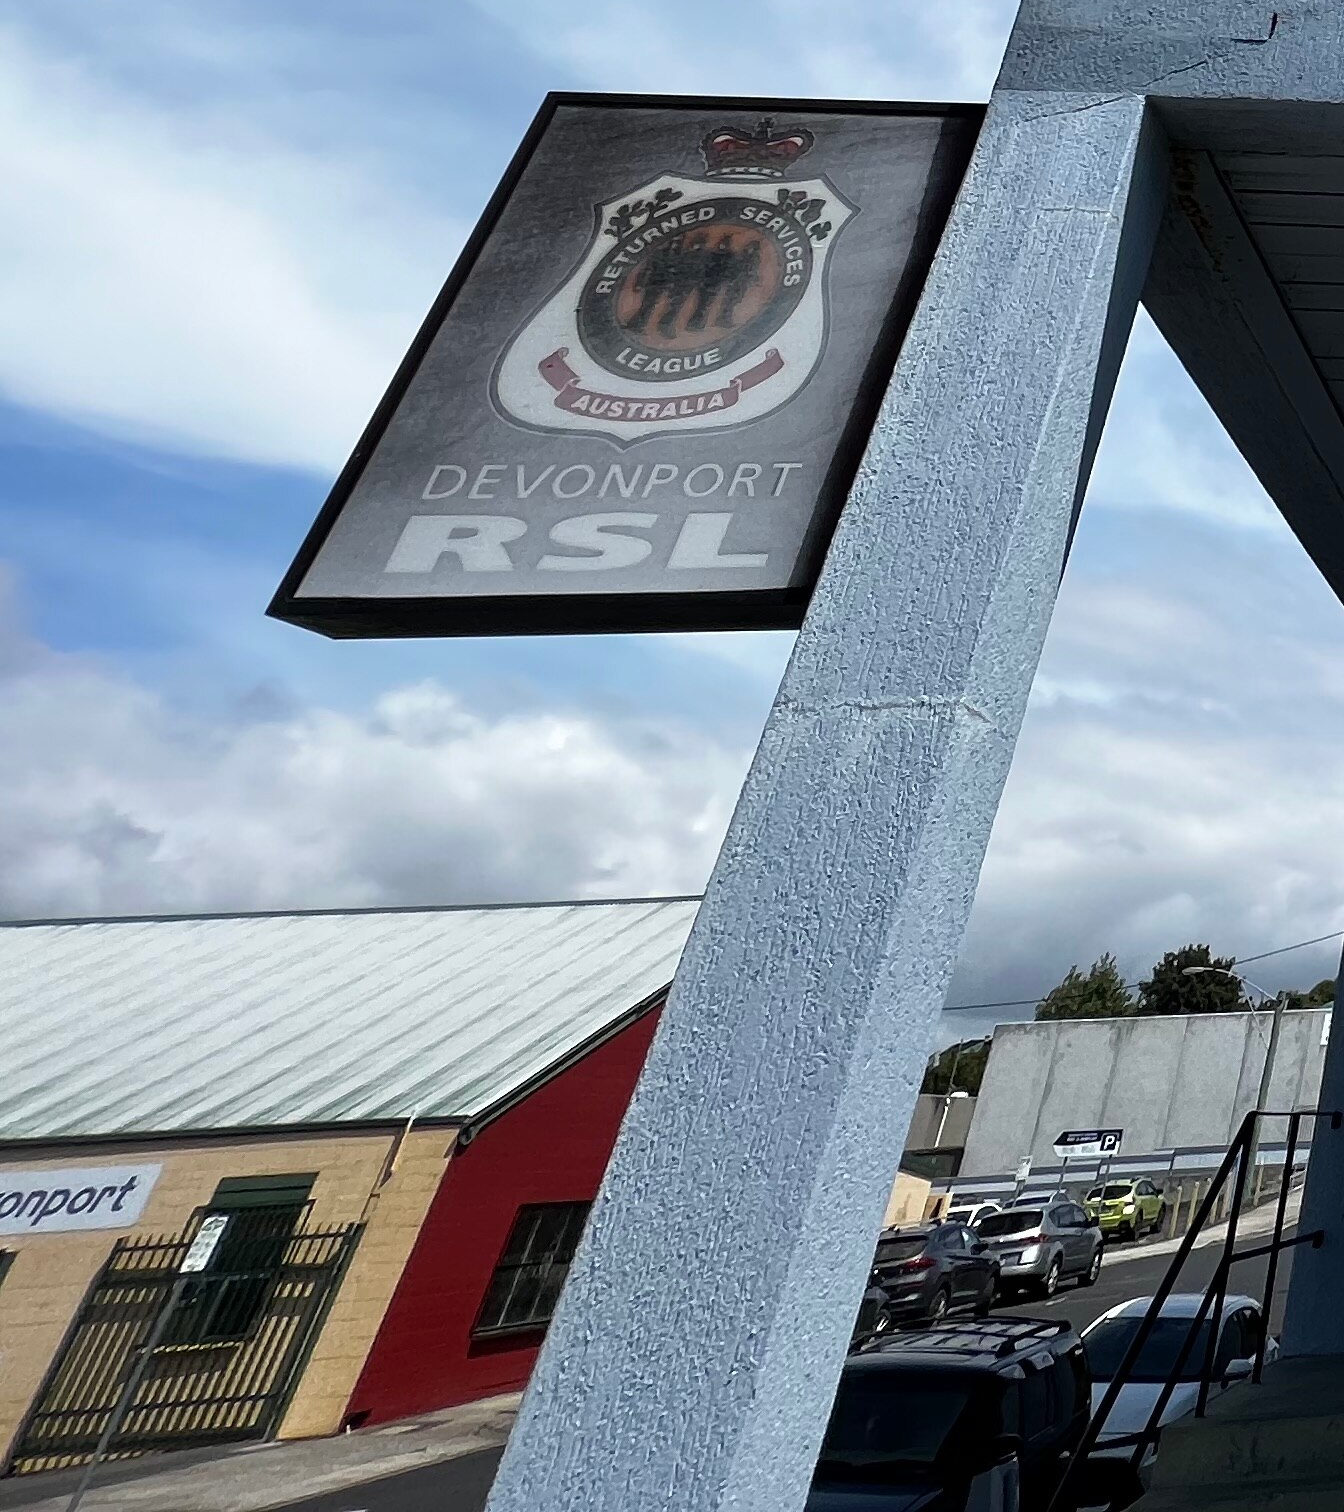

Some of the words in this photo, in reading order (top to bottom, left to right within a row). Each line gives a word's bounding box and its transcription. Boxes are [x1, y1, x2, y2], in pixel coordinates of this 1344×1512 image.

[595, 205, 717, 295] RETURNED
[739, 206, 804, 288] SERVICES
[615, 346, 723, 375] LEAGUE
[570, 392, 725, 420] AUSTRALIA
[421, 462, 803, 501] DEVONPORT
[383, 511, 770, 575] RSL
[1104, 1135, 1116, 1150] P
[0, 1175, 139, 1227] onport
